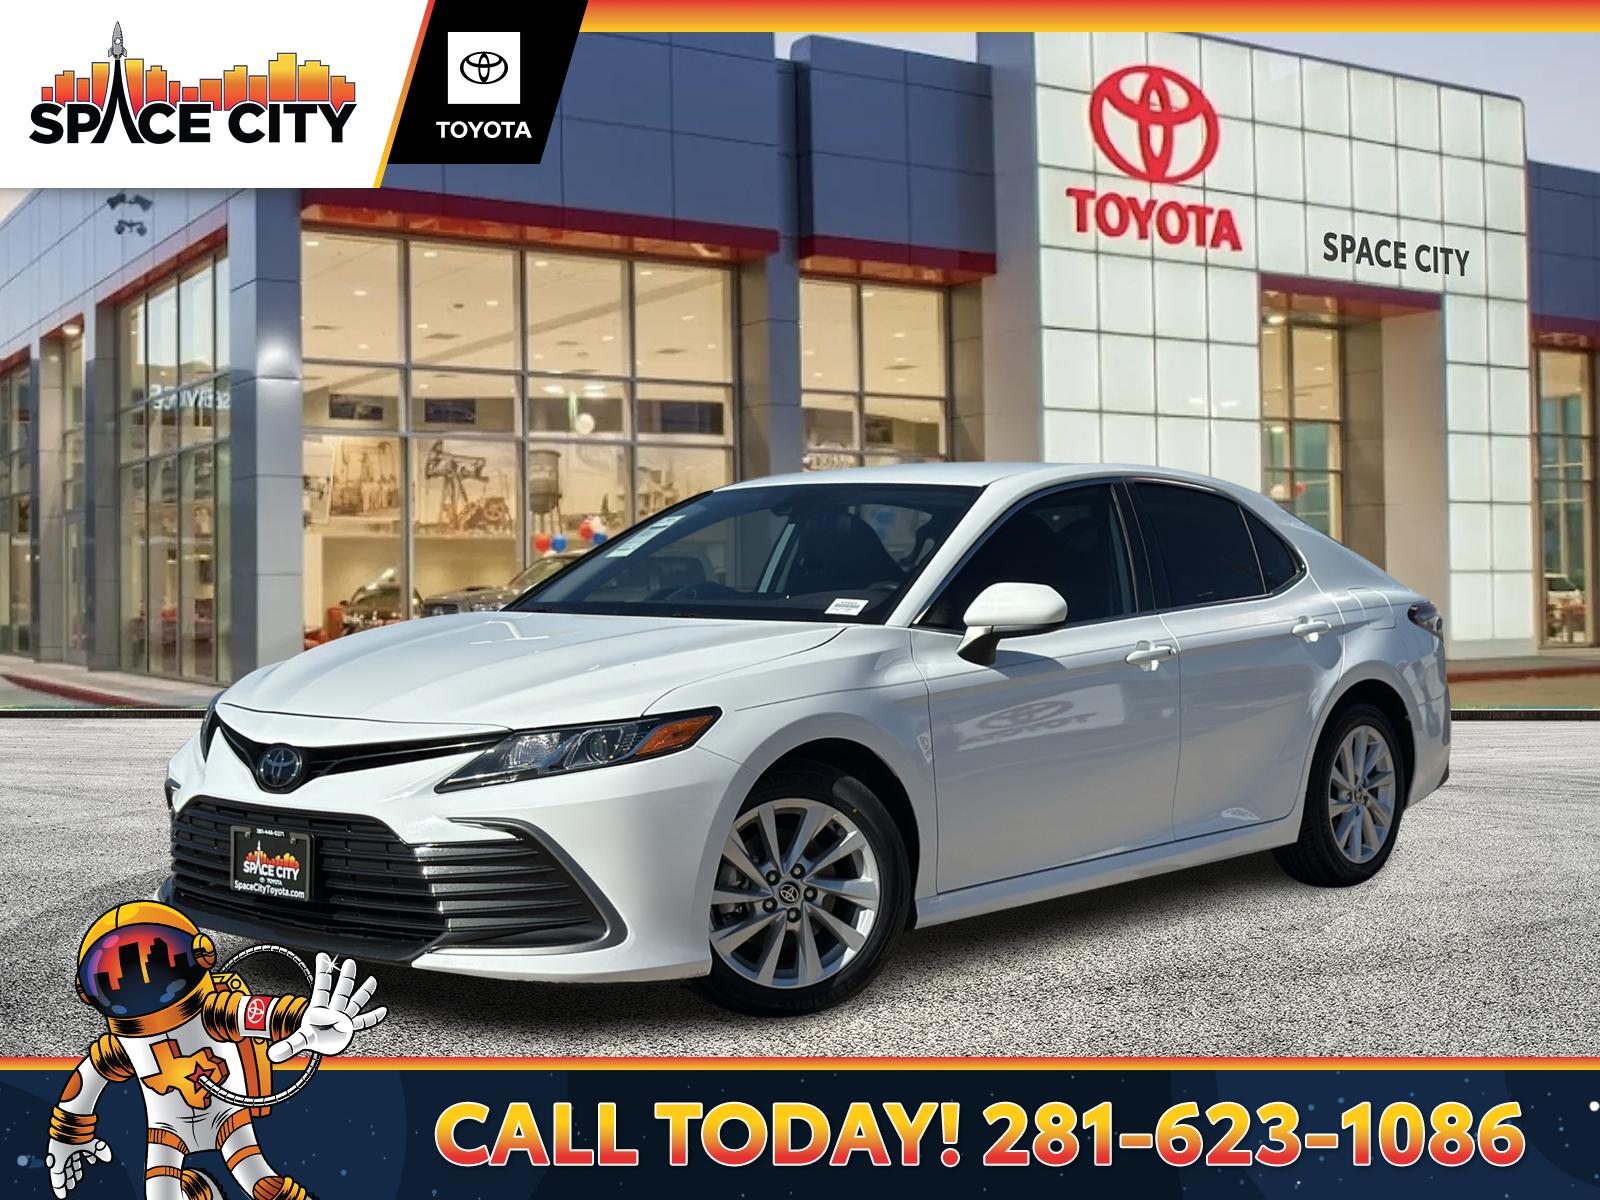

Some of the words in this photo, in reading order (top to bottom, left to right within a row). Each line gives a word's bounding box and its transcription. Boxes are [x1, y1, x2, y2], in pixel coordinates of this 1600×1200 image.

[1067, 188, 1242, 251] TOYOTA
[1323, 232, 1407, 270] SPACE
[1414, 244, 1471, 277] CITY
[243, 860, 275, 877] SPACE
[276, 866, 300, 881] CITY
[234, 880, 305, 899] SpaceCityToyota.com
